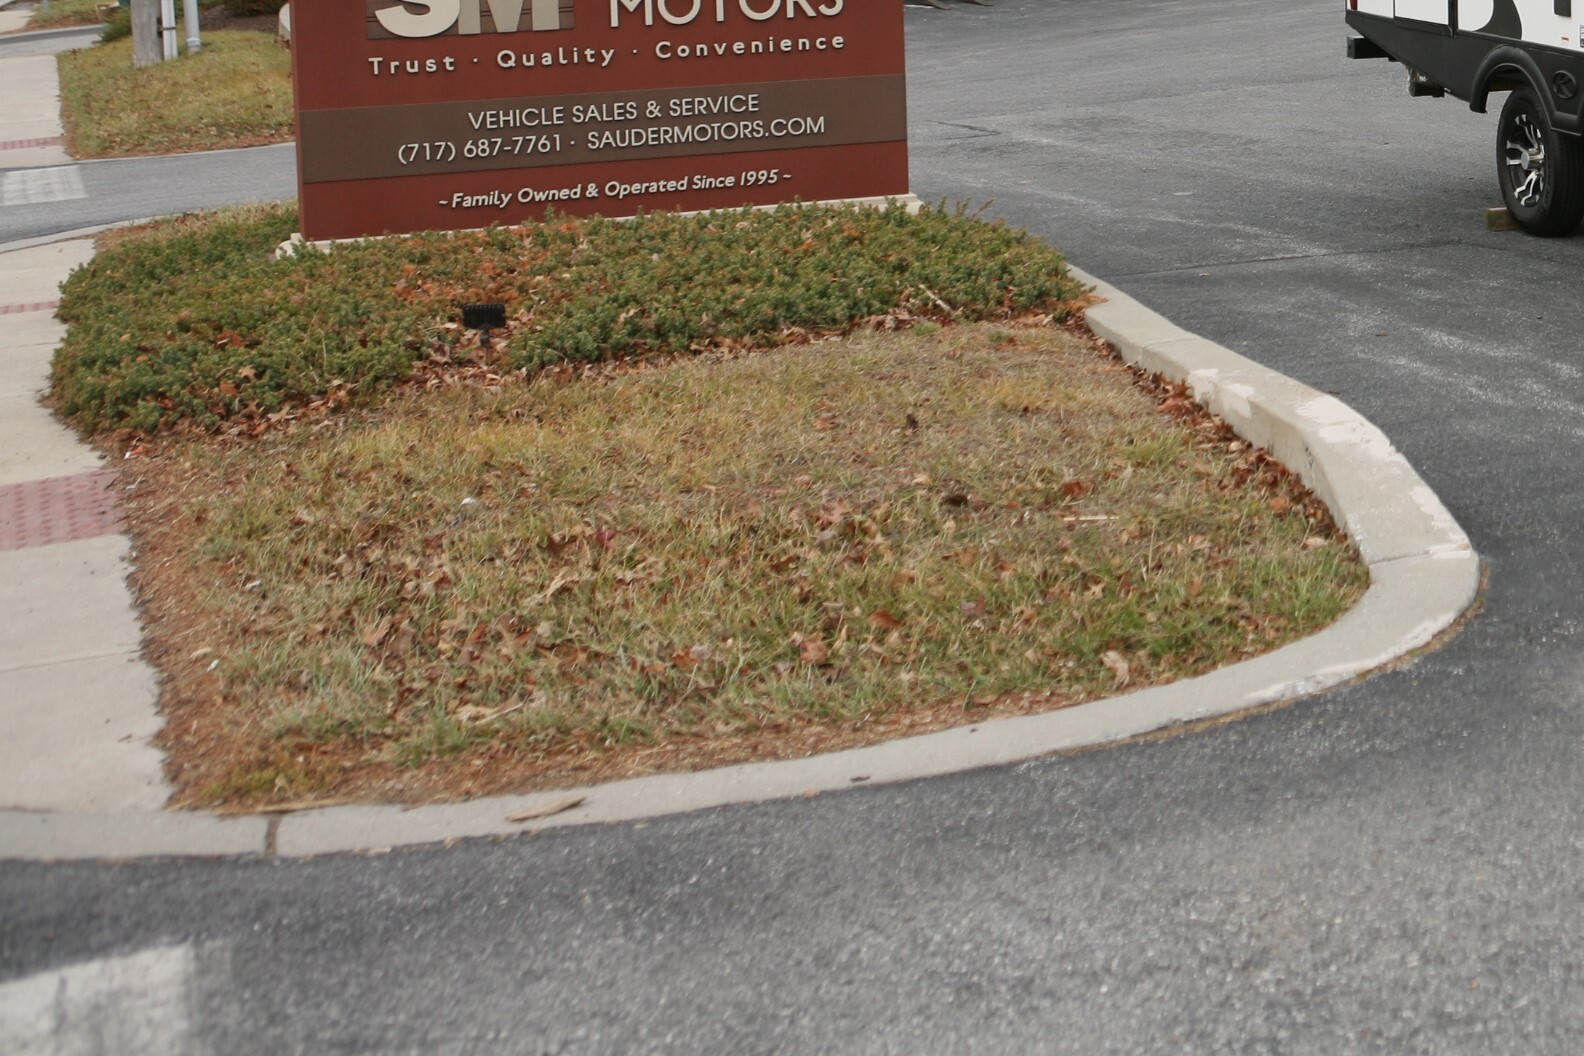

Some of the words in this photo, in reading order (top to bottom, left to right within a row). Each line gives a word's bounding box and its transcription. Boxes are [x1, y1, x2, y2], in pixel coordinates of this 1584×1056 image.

[368, 55, 455, 75] Trust
[496, 46, 615, 67] Quality
[655, 35, 844, 59] Convenience
[467, 106, 565, 130] VEHICLE
[571, 101, 638, 123] SALES
[645, 100, 662, 118] &
[668, 93, 760, 117] SERVICE
[398, 141, 456, 165] (717)
[463, 133, 561, 158] 687-7761
[587, 115, 825, 150] SAUDERMOTORS.COM
[517, 183, 582, 203] Owned
[585, 182, 599, 198] &
[604, 176, 688, 199] Operated
[691, 175, 736, 190] Since
